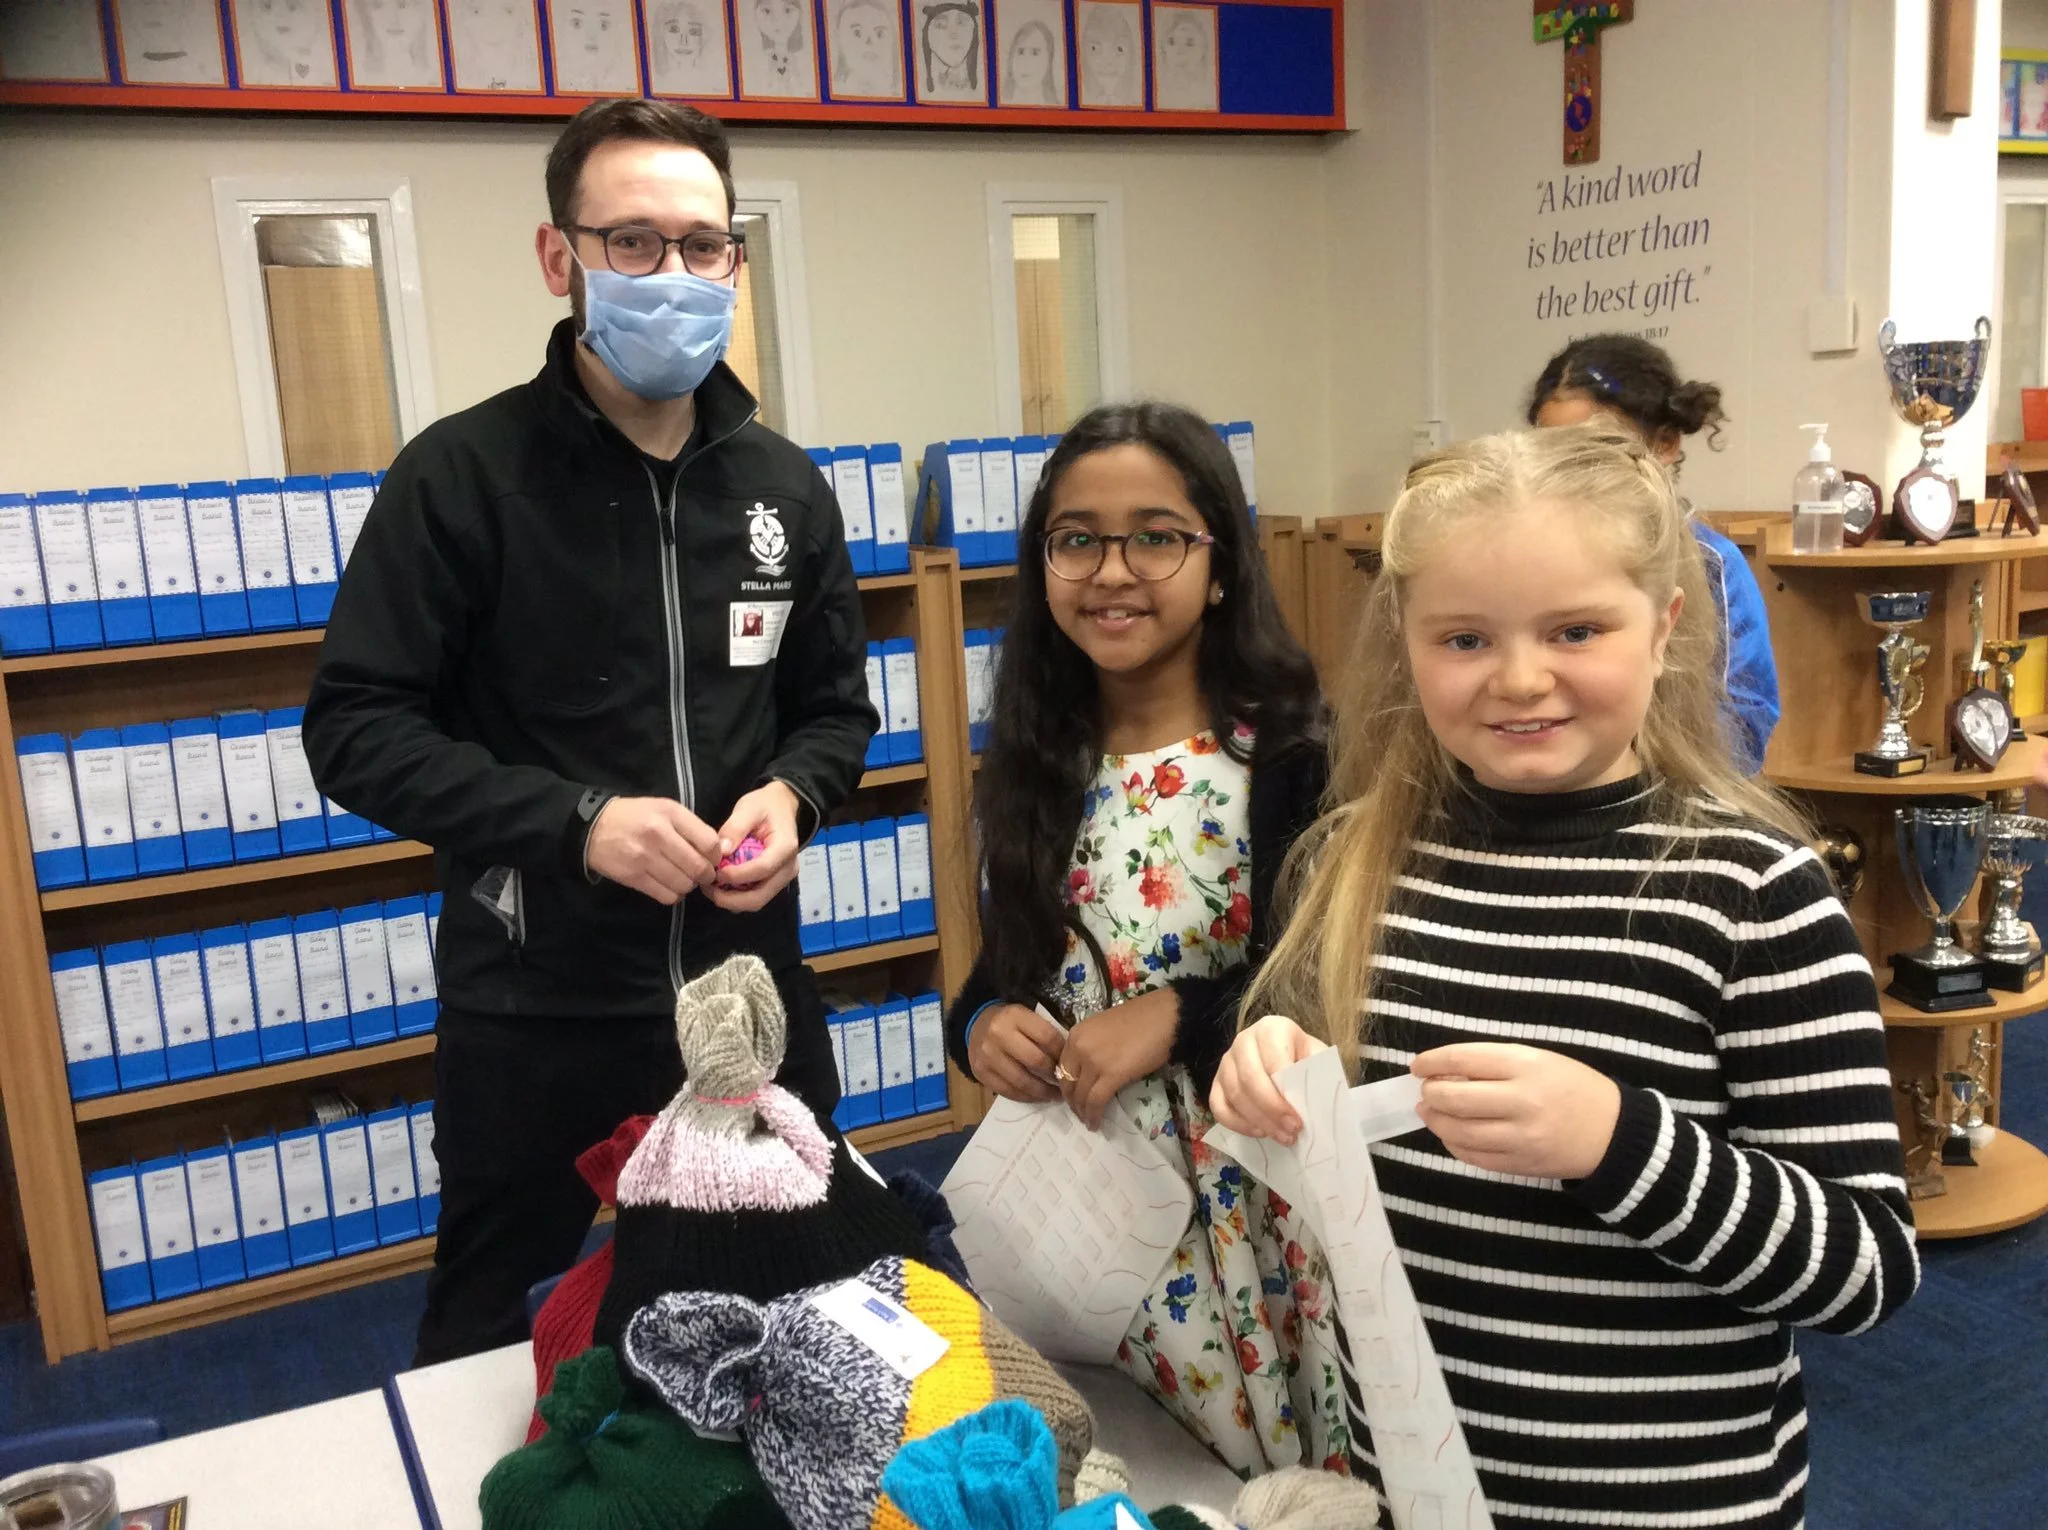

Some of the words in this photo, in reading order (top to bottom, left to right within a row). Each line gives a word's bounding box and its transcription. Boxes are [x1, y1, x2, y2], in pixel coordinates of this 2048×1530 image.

[1562, 165, 1622, 211] kind
[1626, 148, 1702, 200] word
[1527, 237, 1546, 269] is
[1551, 228, 1637, 266] better
[1641, 214, 1710, 254] than
[1536, 285, 1577, 320] the
[1582, 279, 1639, 315] best
[740, 580, 771, 591] STELLA
